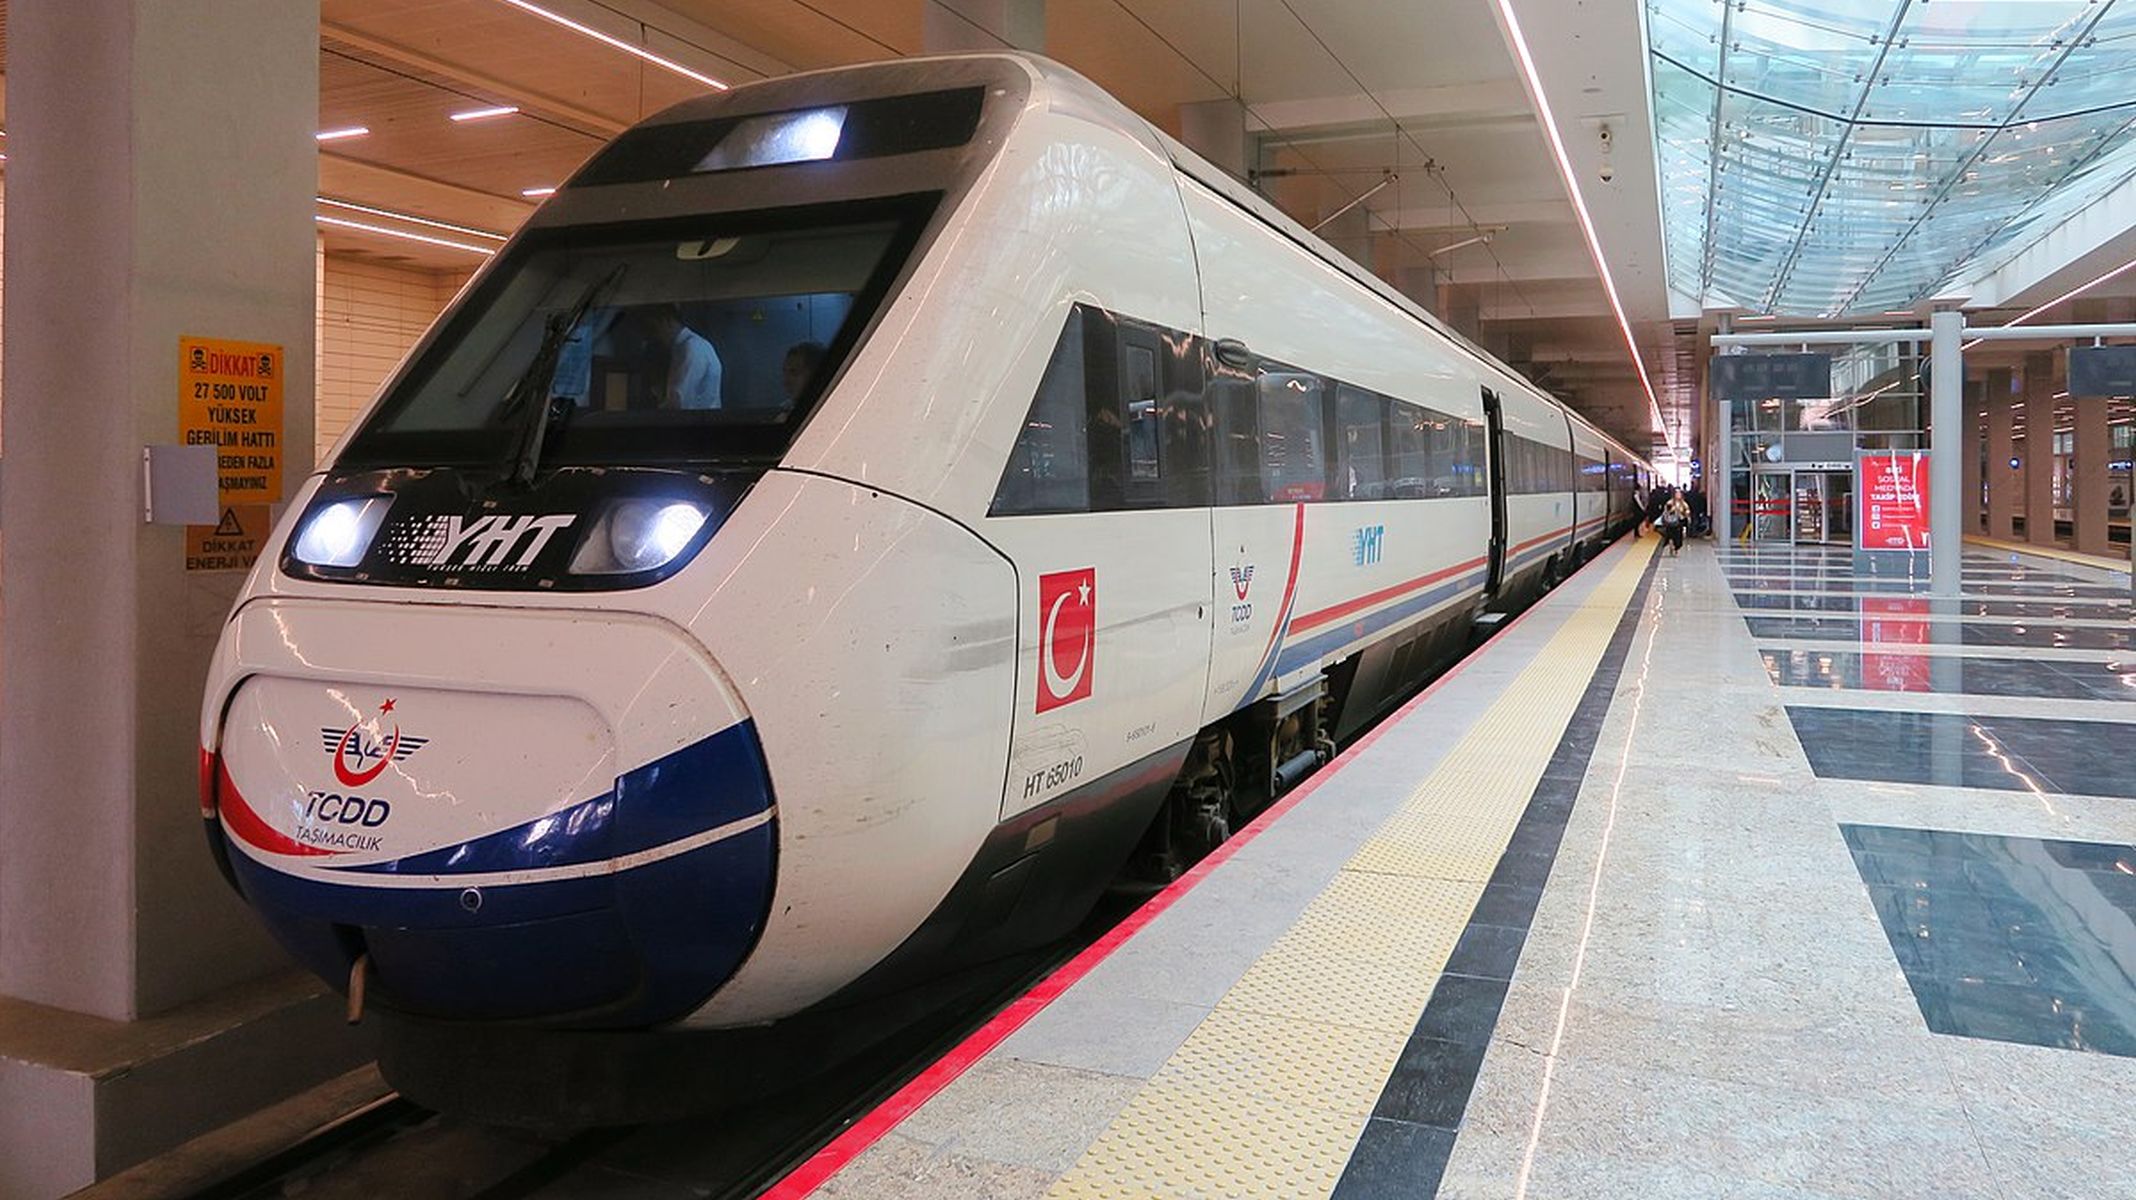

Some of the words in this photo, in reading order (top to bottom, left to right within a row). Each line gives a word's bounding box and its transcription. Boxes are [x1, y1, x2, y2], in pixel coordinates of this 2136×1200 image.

[210, 350, 256, 377] DİKKAT
[194, 382, 210, 399] 27
[213, 383, 236, 400] 500
[239, 385, 268, 402] VOLT
[207, 403, 257, 424] YÜKSEK
[241, 431, 275, 448] HATTI
[432, 514, 577, 566] YHT
[1358, 525, 1384, 566] YHT
[1023, 770, 1046, 799] HT
[1047, 755, 1083, 789] 65010
[305, 790, 390, 827] TCDD
[296, 826, 383, 852] TAŞIMACILIK
